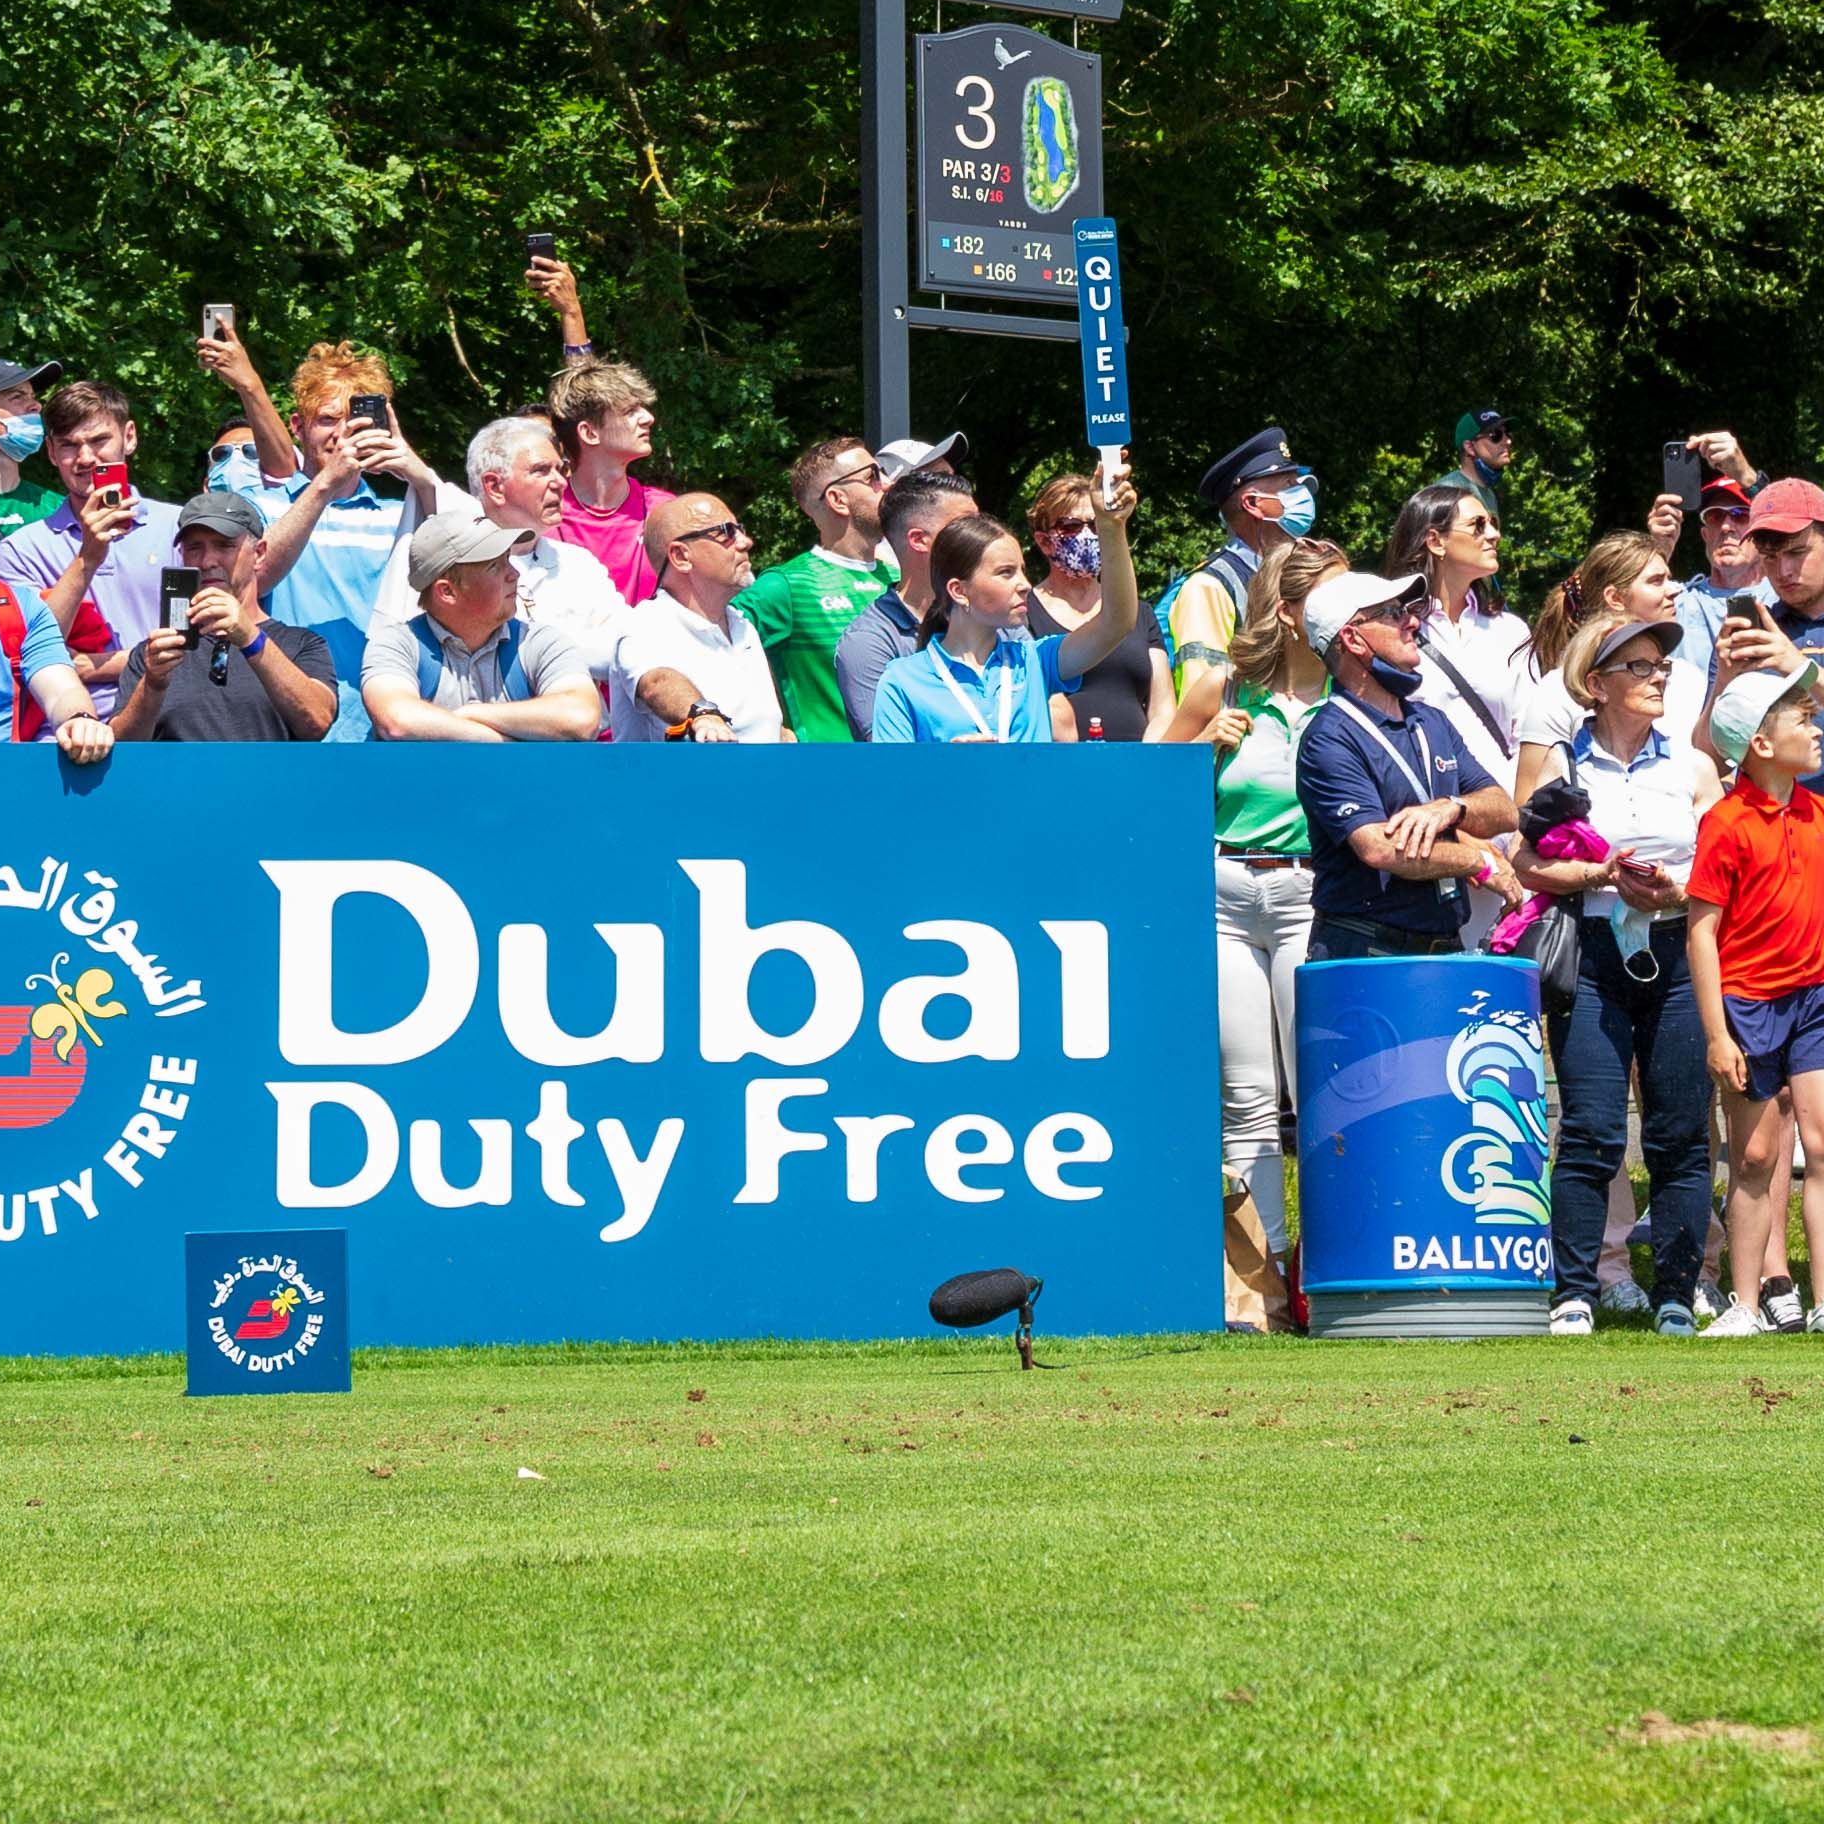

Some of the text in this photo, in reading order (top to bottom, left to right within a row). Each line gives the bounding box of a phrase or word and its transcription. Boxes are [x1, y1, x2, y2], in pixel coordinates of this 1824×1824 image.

[954, 75, 996, 150] 3
[942, 158, 1011, 185] PAR 3/3
[951, 185, 1004, 204] S.I. 6/16
[998, 219, 1028, 229] YARDS
[953, 236, 1052, 262] 182 174
[985, 262, 1078, 287] 166 12
[1084, 256, 1116, 402] QUIET
[1091, 412, 1126, 424] PLEASE
[259, 859, 1111, 1067] Dubai
[103, 1055, 198, 1188] FREE
[265, 1078, 1113, 1243] Duty Free
[1393, 1236, 1554, 1270] BALLYGO
[207, 1313, 324, 1373] DUBAI DUTY FREE
